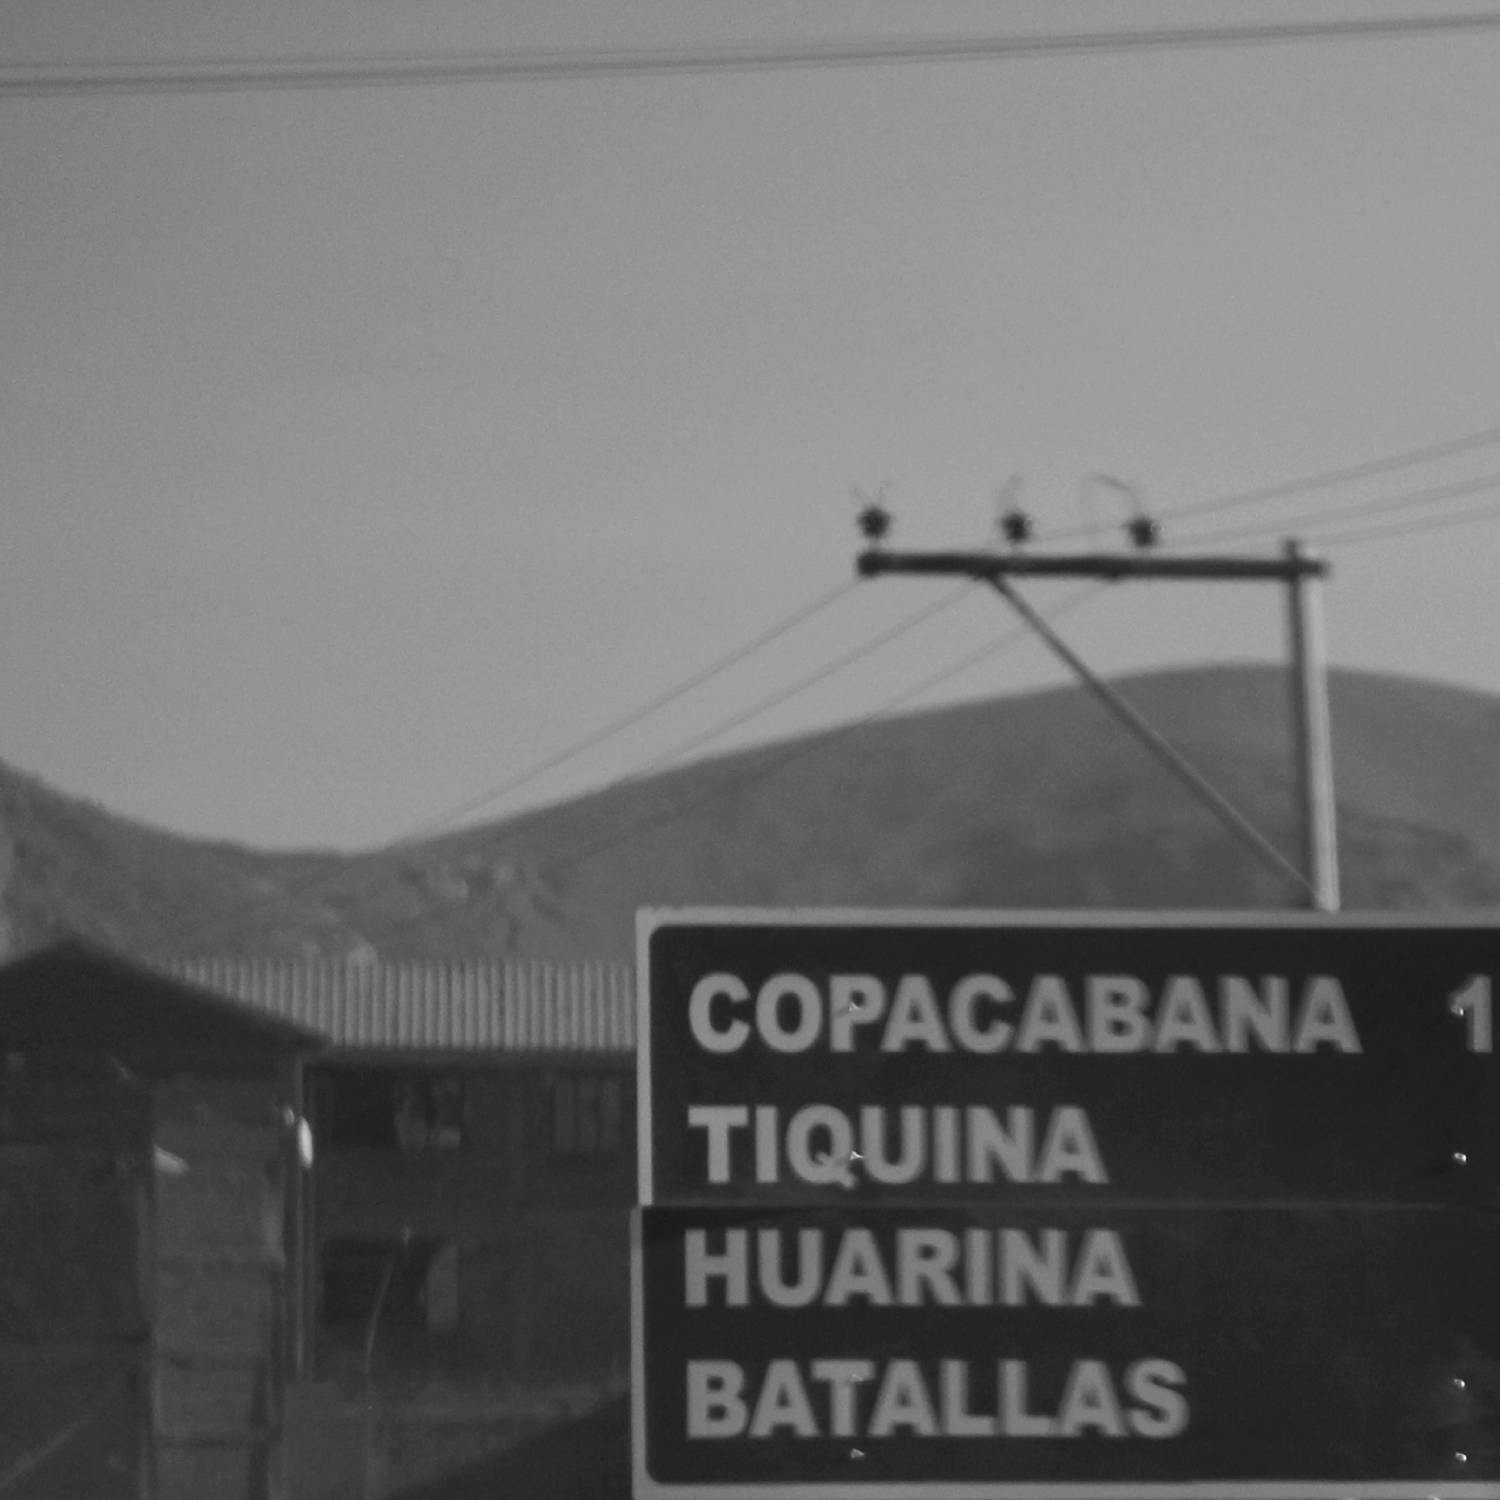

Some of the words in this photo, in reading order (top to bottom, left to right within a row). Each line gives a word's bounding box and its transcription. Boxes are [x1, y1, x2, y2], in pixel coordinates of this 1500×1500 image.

[688, 973, 1361, 1054] COPACABANA
[687, 1104, 1108, 1189] TIQUINA
[685, 1228, 1141, 1307] HUARINA
[686, 1359, 1189, 1438] BATALLAS
